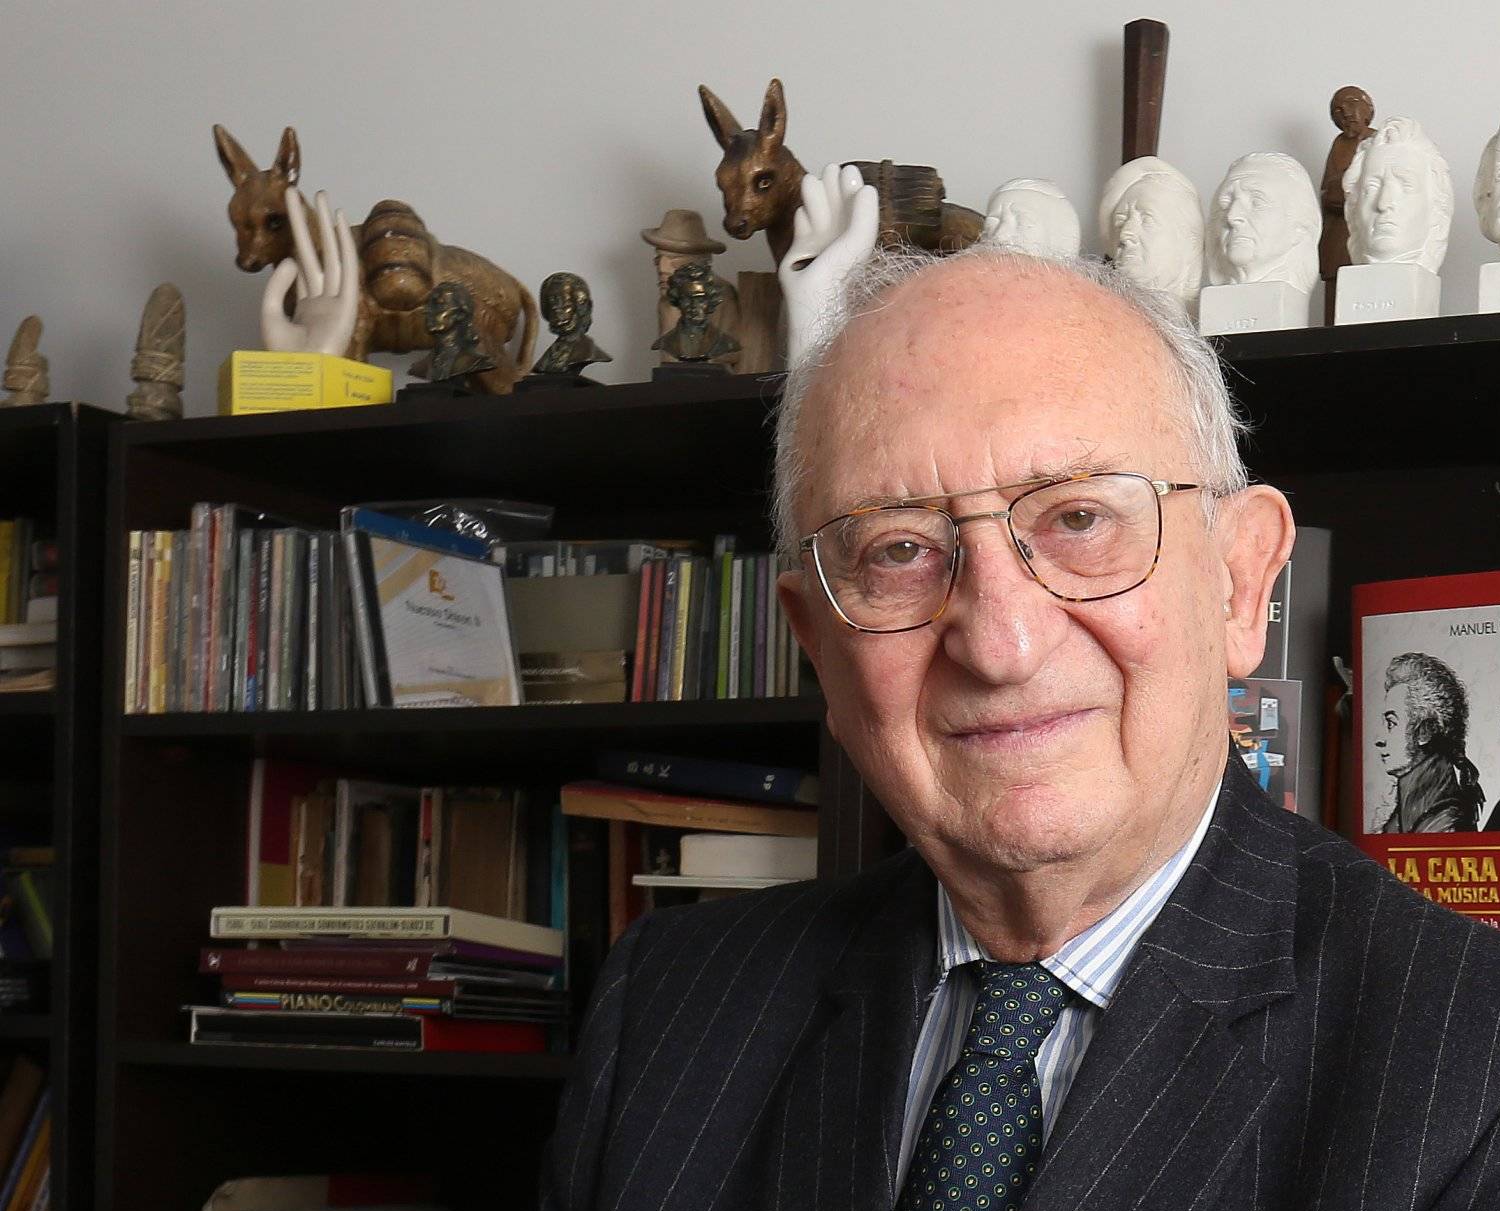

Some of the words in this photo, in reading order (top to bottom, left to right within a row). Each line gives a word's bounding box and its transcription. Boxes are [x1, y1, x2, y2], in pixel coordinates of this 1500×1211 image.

[1450, 621, 1496, 636] MANUEL
[1387, 858, 1420, 883] LA
[1428, 857, 1498, 883] CARA
[1438, 884, 1499, 903] MÚSICA
